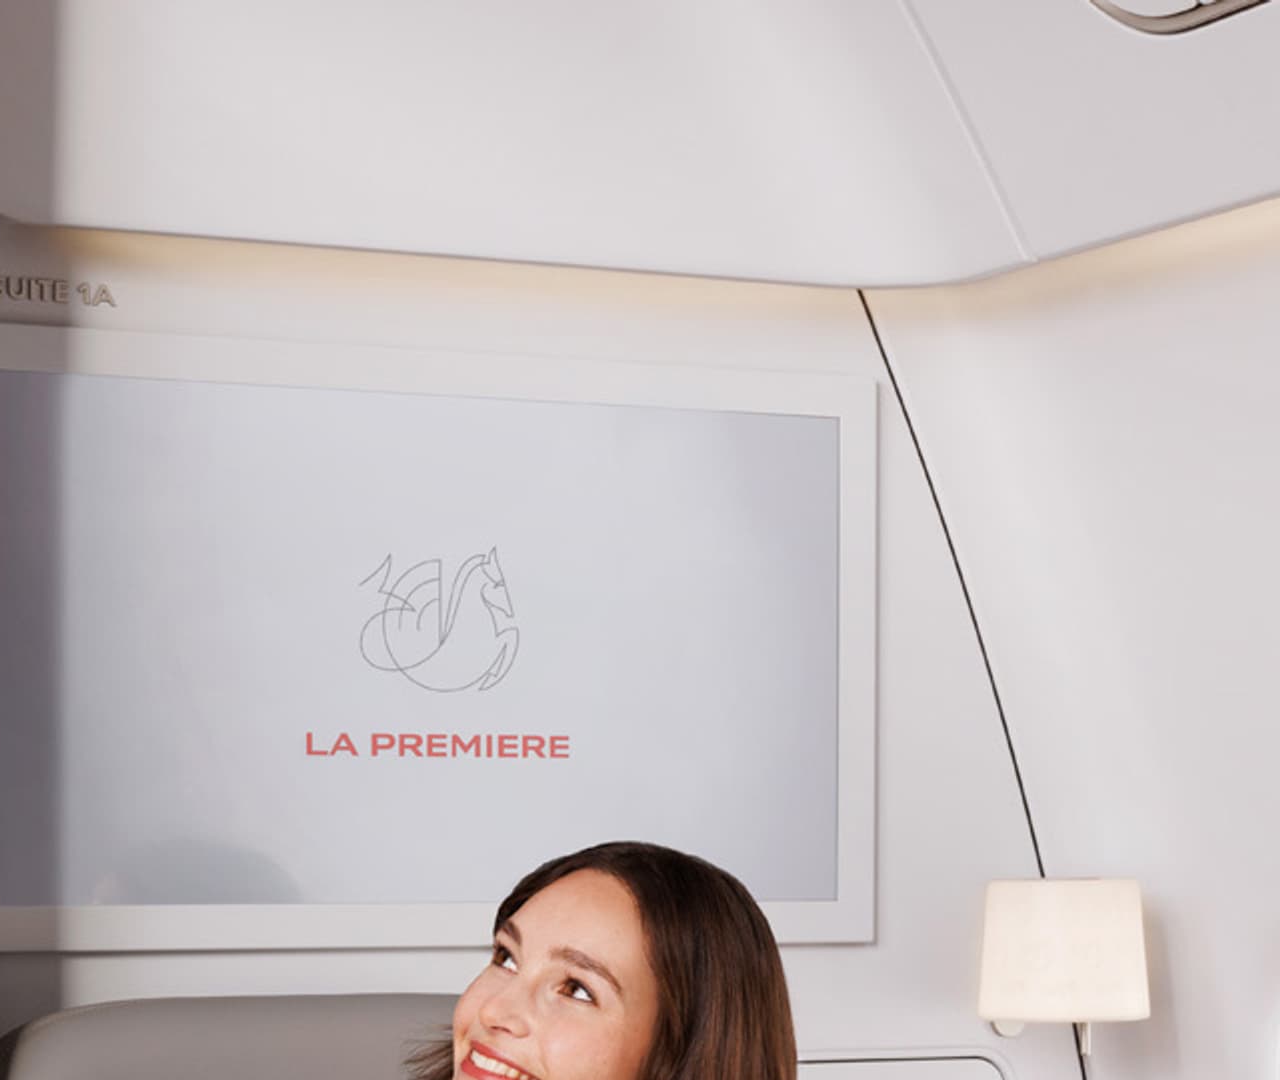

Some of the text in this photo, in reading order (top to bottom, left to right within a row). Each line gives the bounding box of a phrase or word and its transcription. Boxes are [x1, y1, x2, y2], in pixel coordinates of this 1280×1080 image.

[76, 281, 117, 307] 1A
[306, 732, 570, 759] LA PREMIERE
